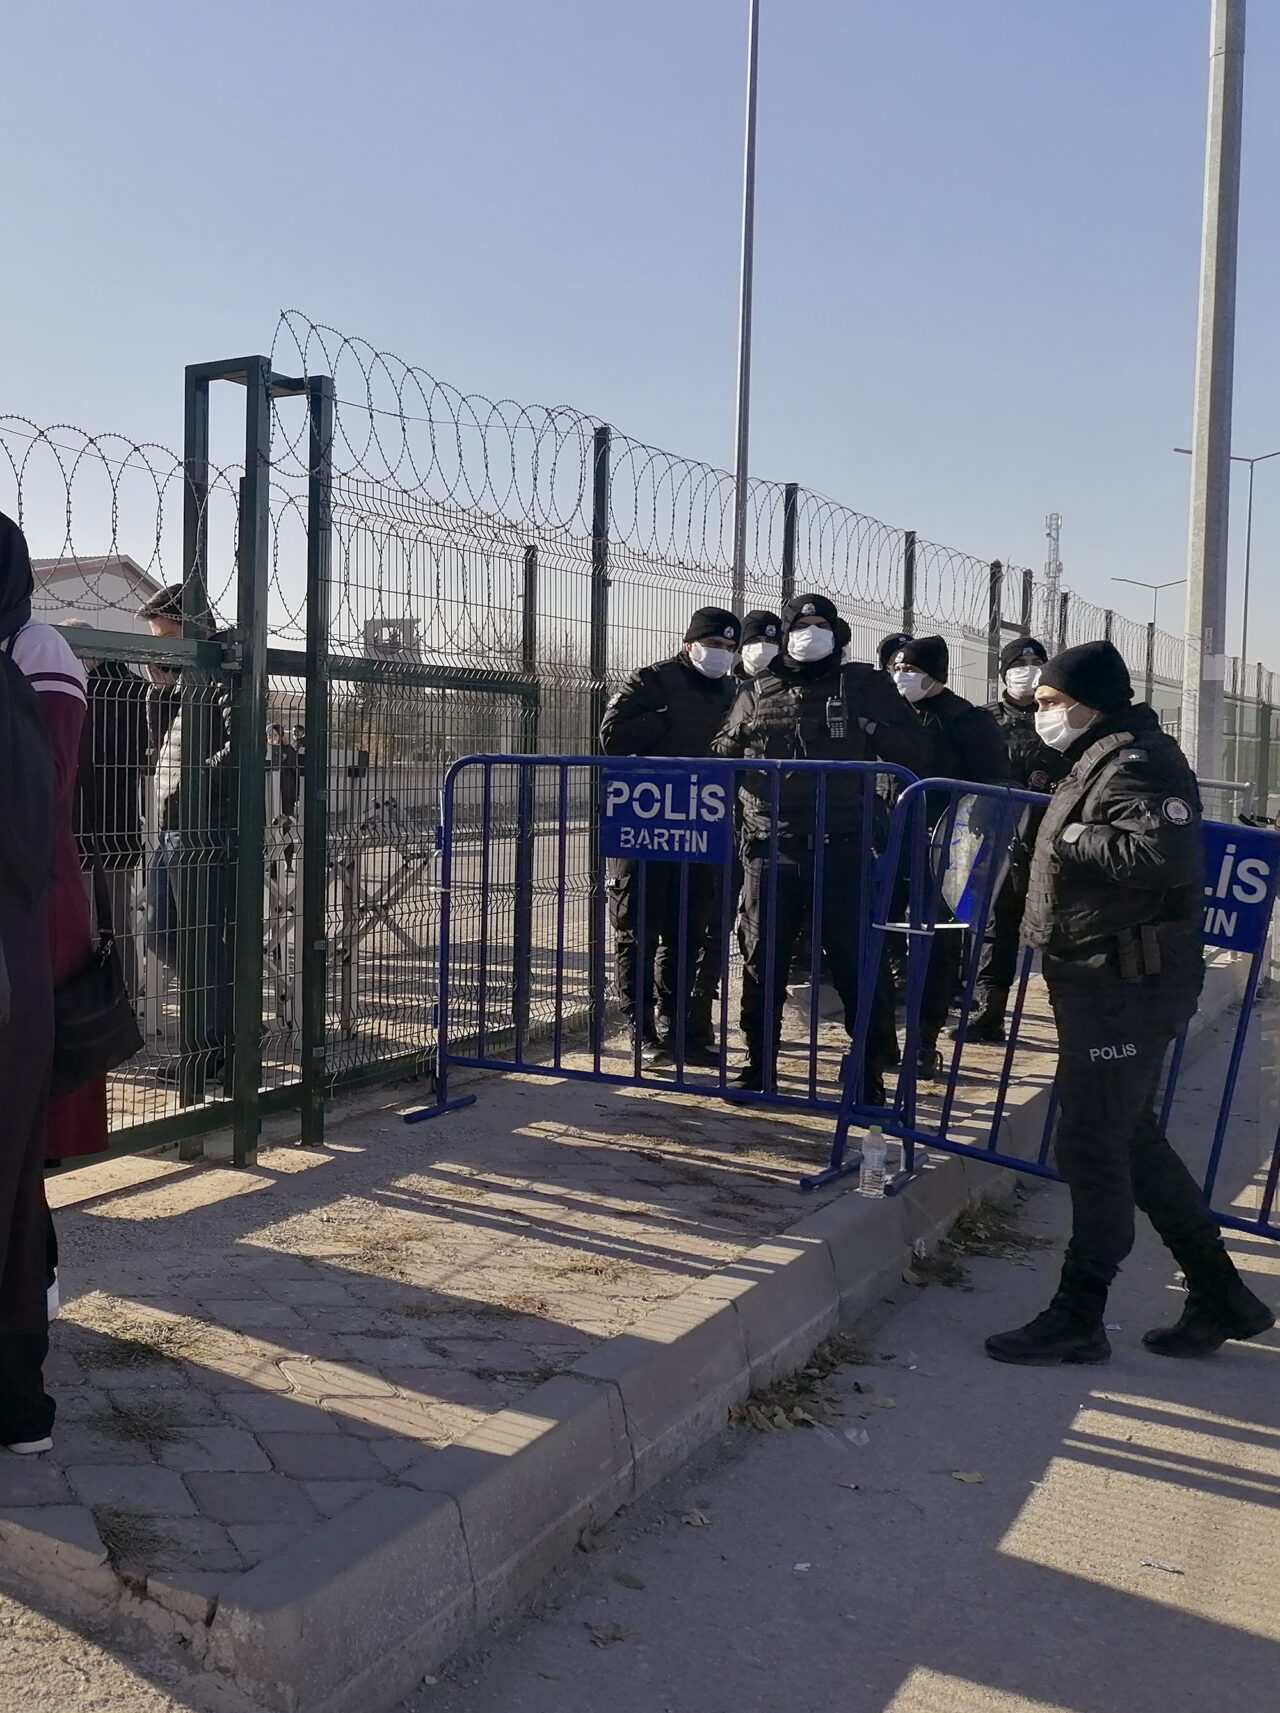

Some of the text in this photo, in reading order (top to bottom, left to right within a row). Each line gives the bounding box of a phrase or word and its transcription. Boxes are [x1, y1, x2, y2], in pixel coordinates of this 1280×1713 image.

[606, 774, 726, 822] POLİS
[620, 826, 709, 853] BARTIN
[1203, 905, 1238, 937] IN
